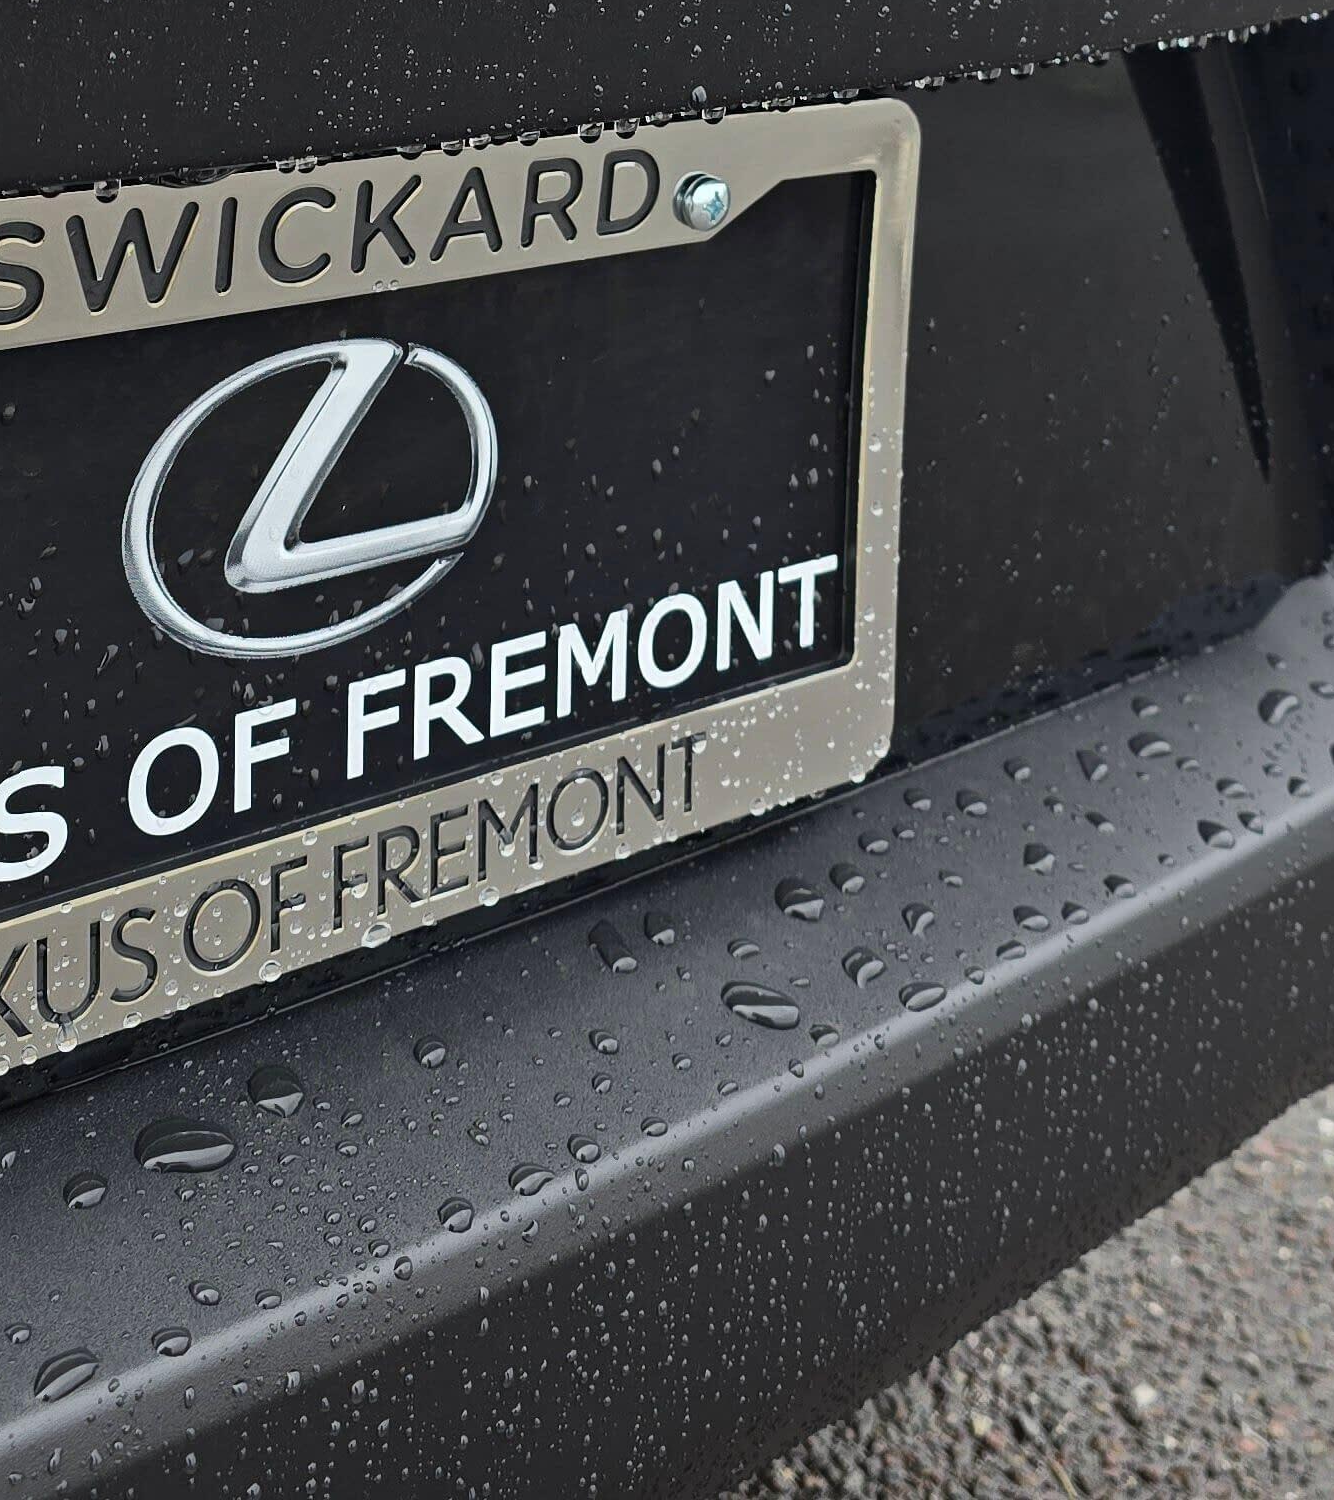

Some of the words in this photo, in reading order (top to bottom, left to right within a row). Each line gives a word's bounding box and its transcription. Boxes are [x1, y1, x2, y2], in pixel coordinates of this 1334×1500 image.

[126, 699, 297, 837] OF
[345, 554, 839, 780] FREMONT
[182, 856, 308, 974] OF
[333, 731, 708, 932] FREMONT
